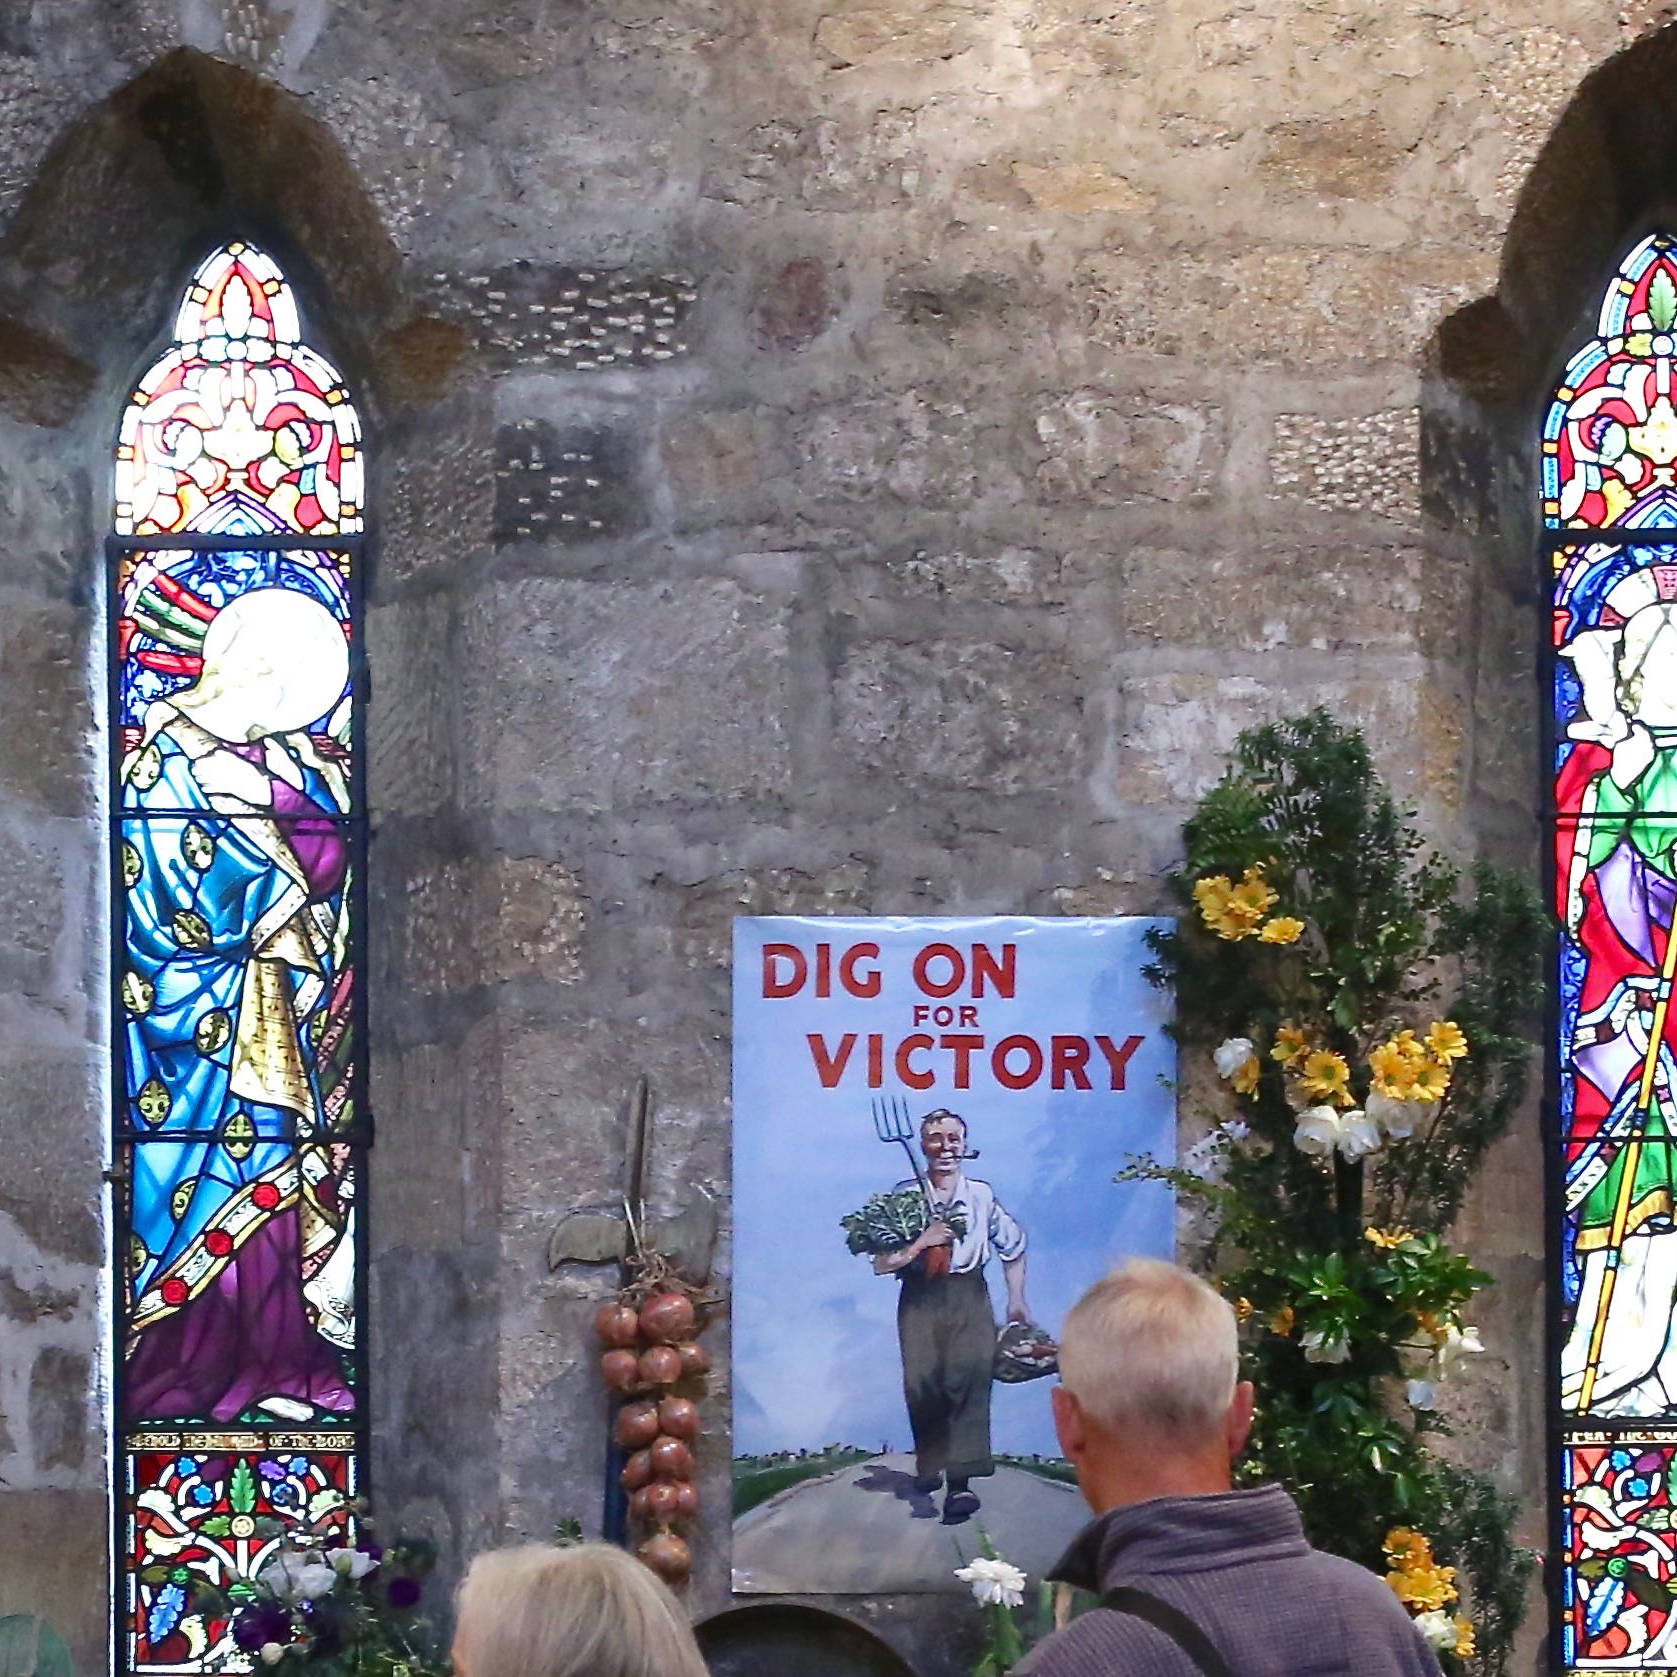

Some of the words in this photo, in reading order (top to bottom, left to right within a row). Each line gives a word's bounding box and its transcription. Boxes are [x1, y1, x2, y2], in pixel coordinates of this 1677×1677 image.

[762, 942, 881, 998] DIG
[912, 942, 1017, 998] ON
[913, 1005, 979, 1027] FOR
[806, 1033, 1146, 1091] VICTORY
